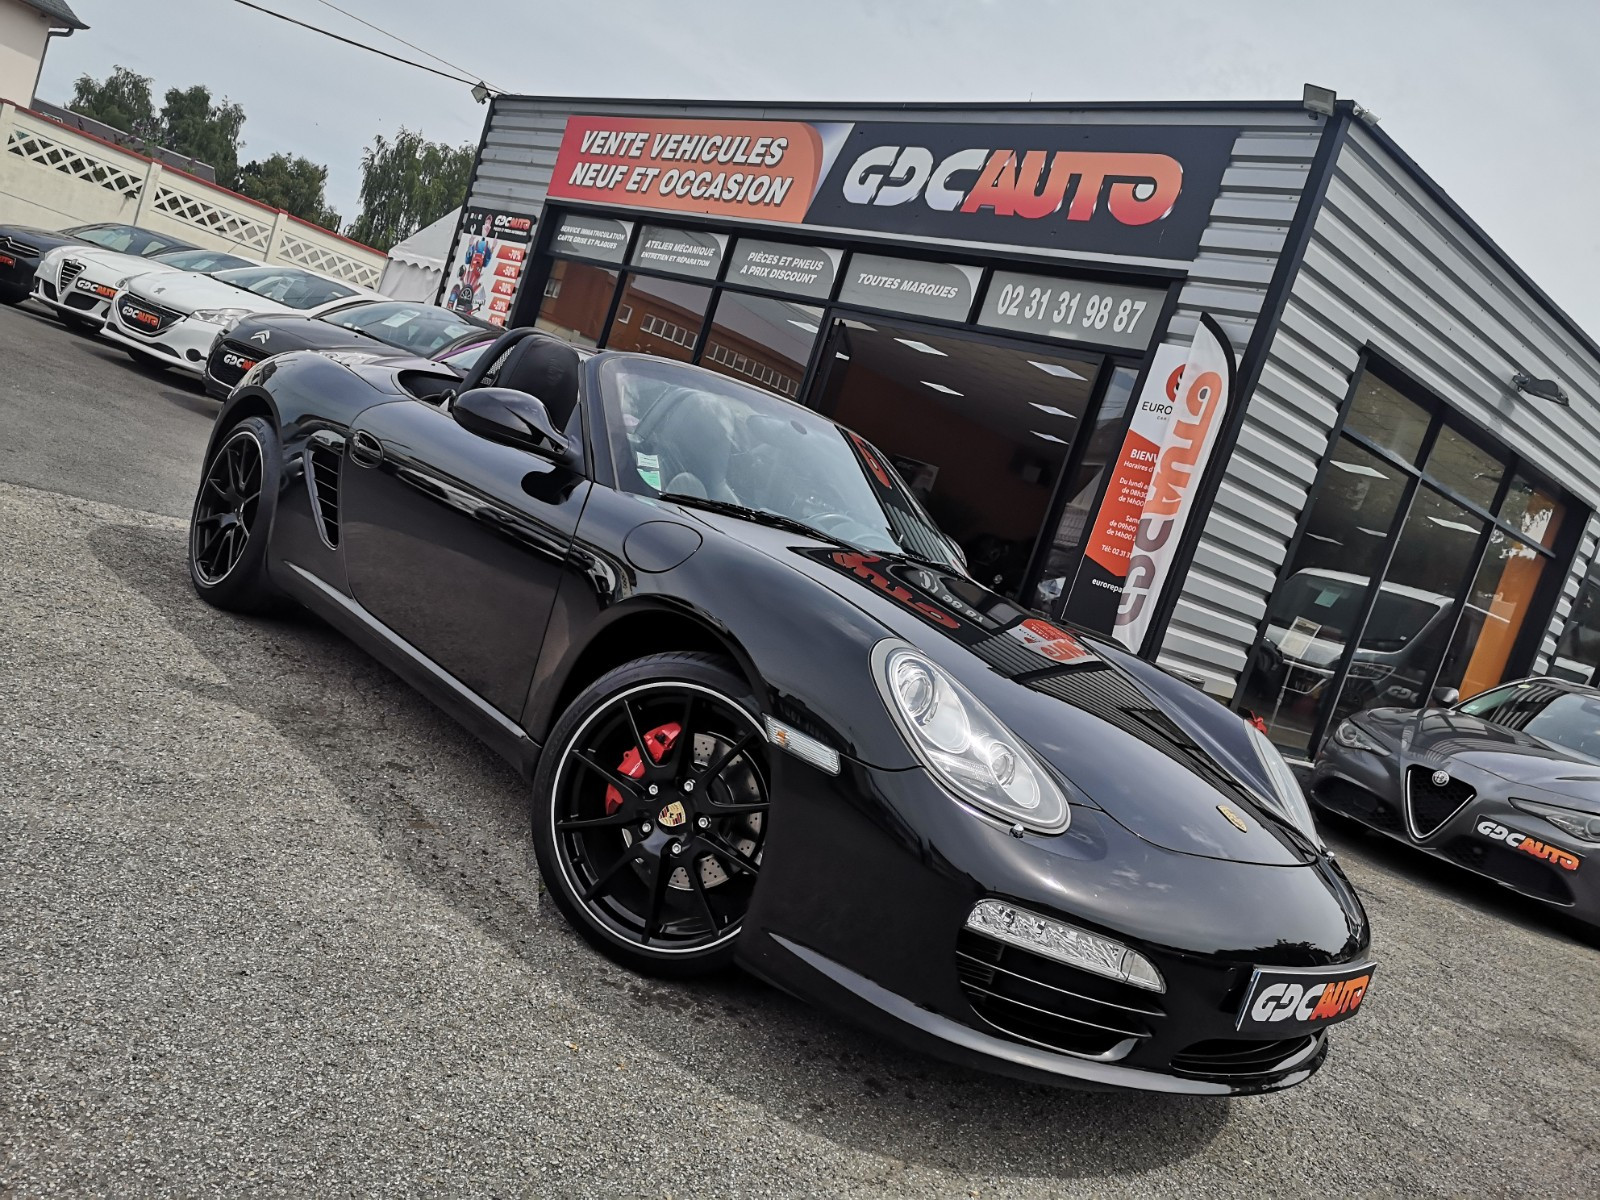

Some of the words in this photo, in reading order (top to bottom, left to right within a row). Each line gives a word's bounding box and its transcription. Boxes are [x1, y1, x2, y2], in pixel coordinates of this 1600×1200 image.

[580, 130, 650, 158] VENTE
[650, 133, 788, 166] VEHICULES
[568, 162, 629, 190] NEUF
[625, 166, 660, 193] ET
[659, 168, 794, 204] OCCASION
[560, 225, 581, 233] SERVICE
[580, 228, 626, 240] IMMATRICULATION
[557, 234, 574, 242] CARTE
[573, 236, 588, 244] GRISE
[594, 240, 618, 249] PLAQUES
[645, 240, 674, 251] ATELIER
[672, 243, 716, 257] MÉCANIQUE
[641, 251, 670, 261] ENTRETIEN
[675, 256, 711, 267] RÉPARATION
[747, 251, 779, 266] PIÈCES
[778, 256, 792, 267] ET
[791, 258, 825, 271] PNEUS
[749, 265, 771, 278] PRIX
[769, 269, 818, 284] DISCOUNT
[857, 273, 901, 289] TOUTES
[899, 280, 959, 299] MARQUES
[997, 284, 1025, 316] 02
[1024, 287, 1052, 320] 31
[1052, 290, 1081, 325] 31
[1082, 294, 1113, 330] 98
[1113, 298, 1148, 334] 87
[1123, 461, 1148, 472] Horaires
[1119, 477, 1128, 485] Du
[1128, 479, 1144, 488] lundi
[1121, 486, 1130, 494] de
[1126, 497, 1145, 507] 14h00
[1106, 528, 1115, 536] de
[1109, 519, 1118, 528] de
[1117, 522, 1137, 532] 09h00
[1111, 547, 1120, 556] 02
